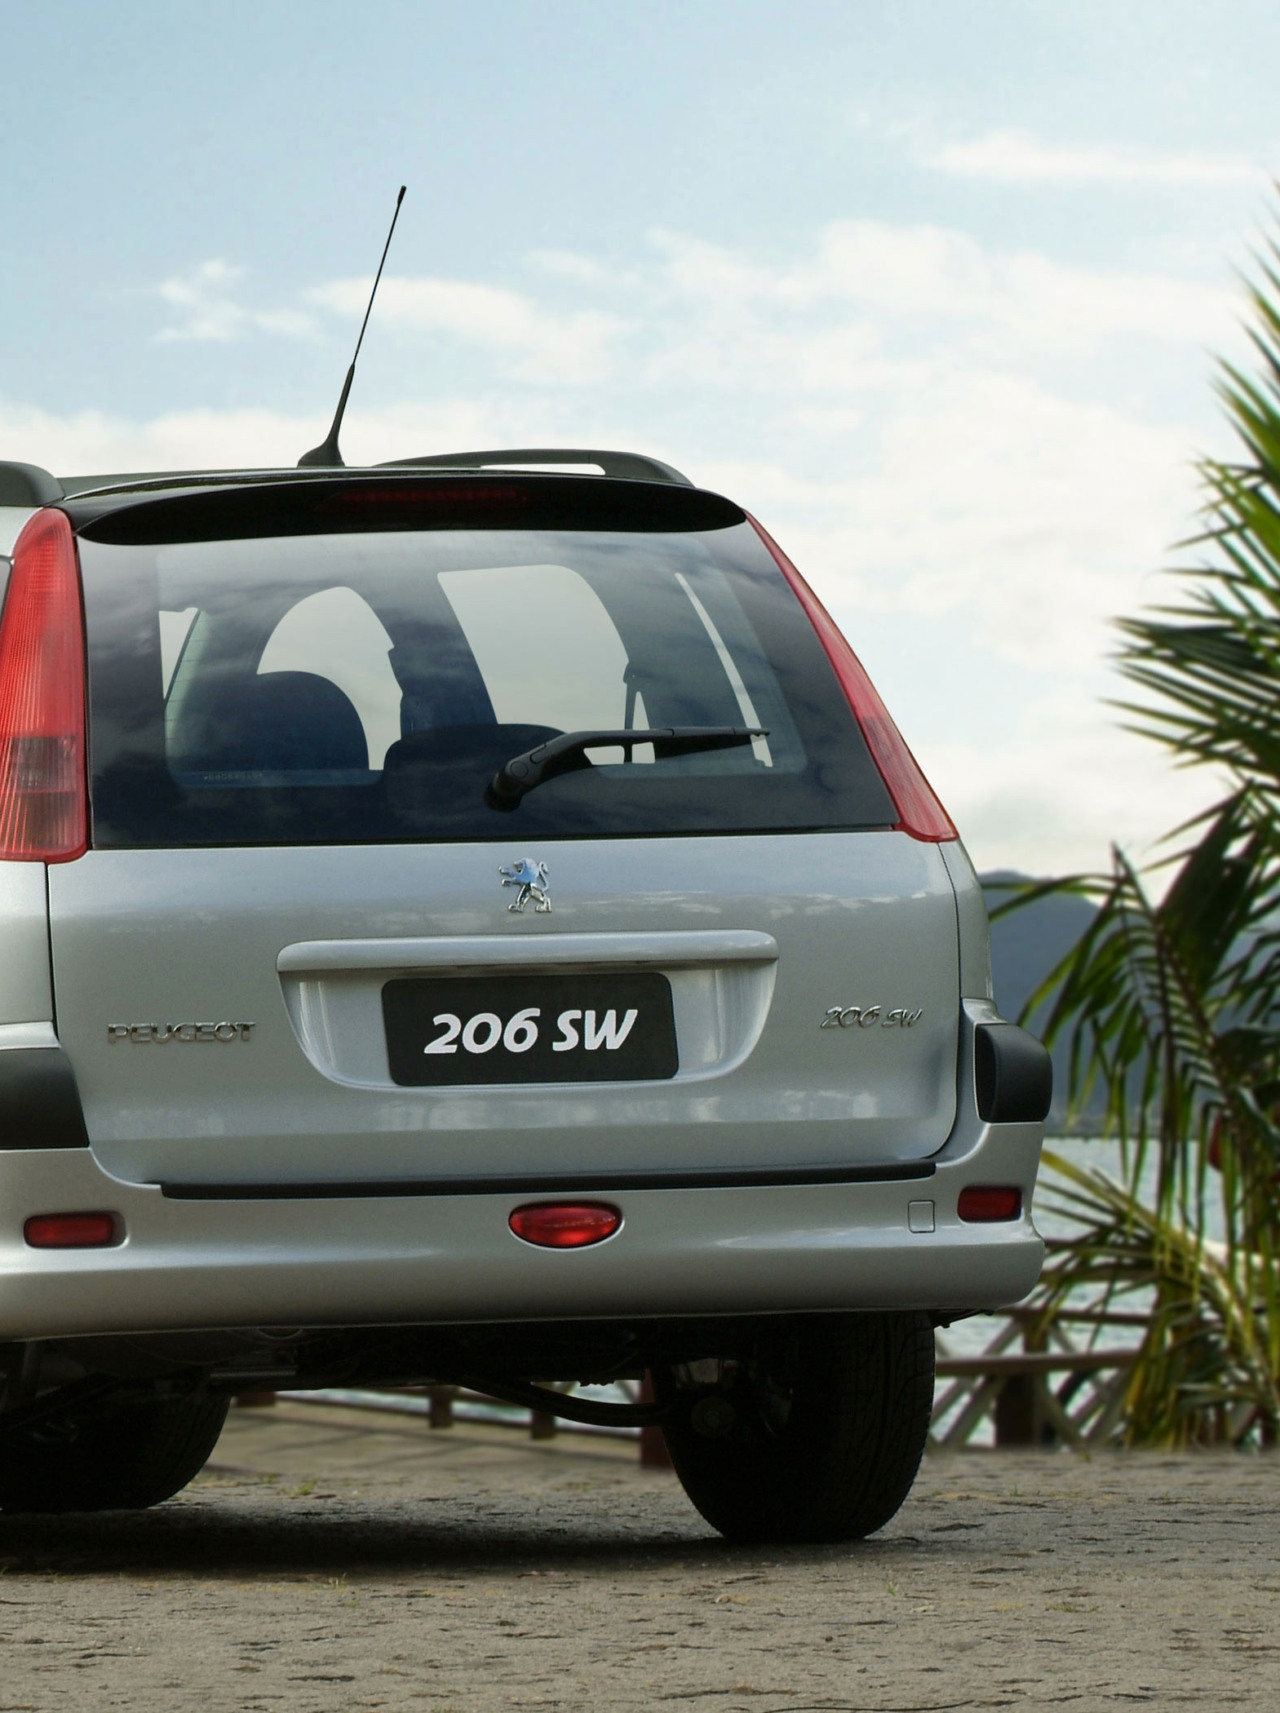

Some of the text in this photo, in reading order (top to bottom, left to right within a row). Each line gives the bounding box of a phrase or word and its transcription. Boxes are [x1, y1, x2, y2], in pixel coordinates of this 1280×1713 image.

[821, 1005, 923, 1028] 206 SW
[108, 1021, 257, 1044] PEUGEOT
[423, 1007, 639, 1053] 206 SW
